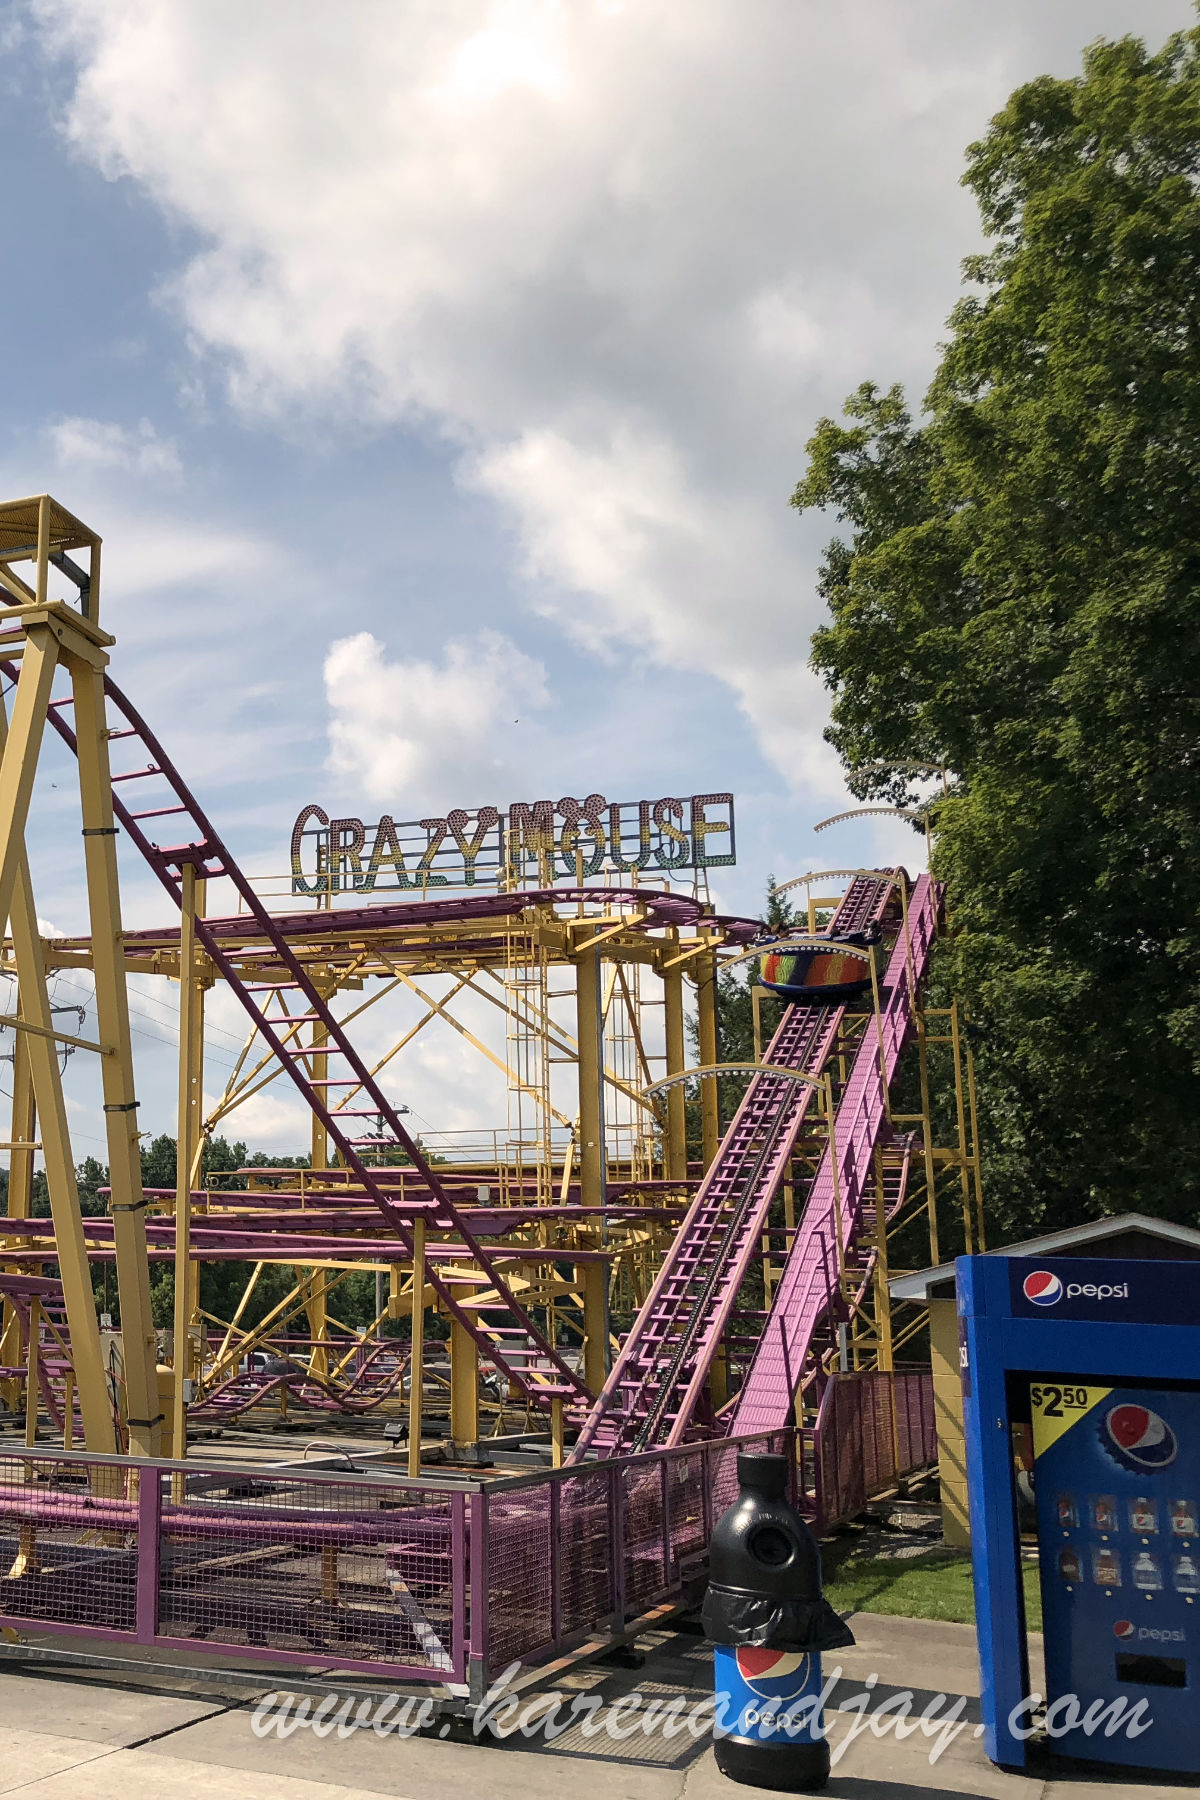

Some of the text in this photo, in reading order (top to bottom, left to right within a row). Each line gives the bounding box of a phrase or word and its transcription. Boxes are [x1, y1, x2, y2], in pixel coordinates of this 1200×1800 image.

[291, 793, 736, 897] CRAZY MOUSE
[1066, 1282, 1129, 1300] pepsi
[1138, 1627, 1186, 1643] pepsi
[745, 1708, 808, 1732] pepsi
